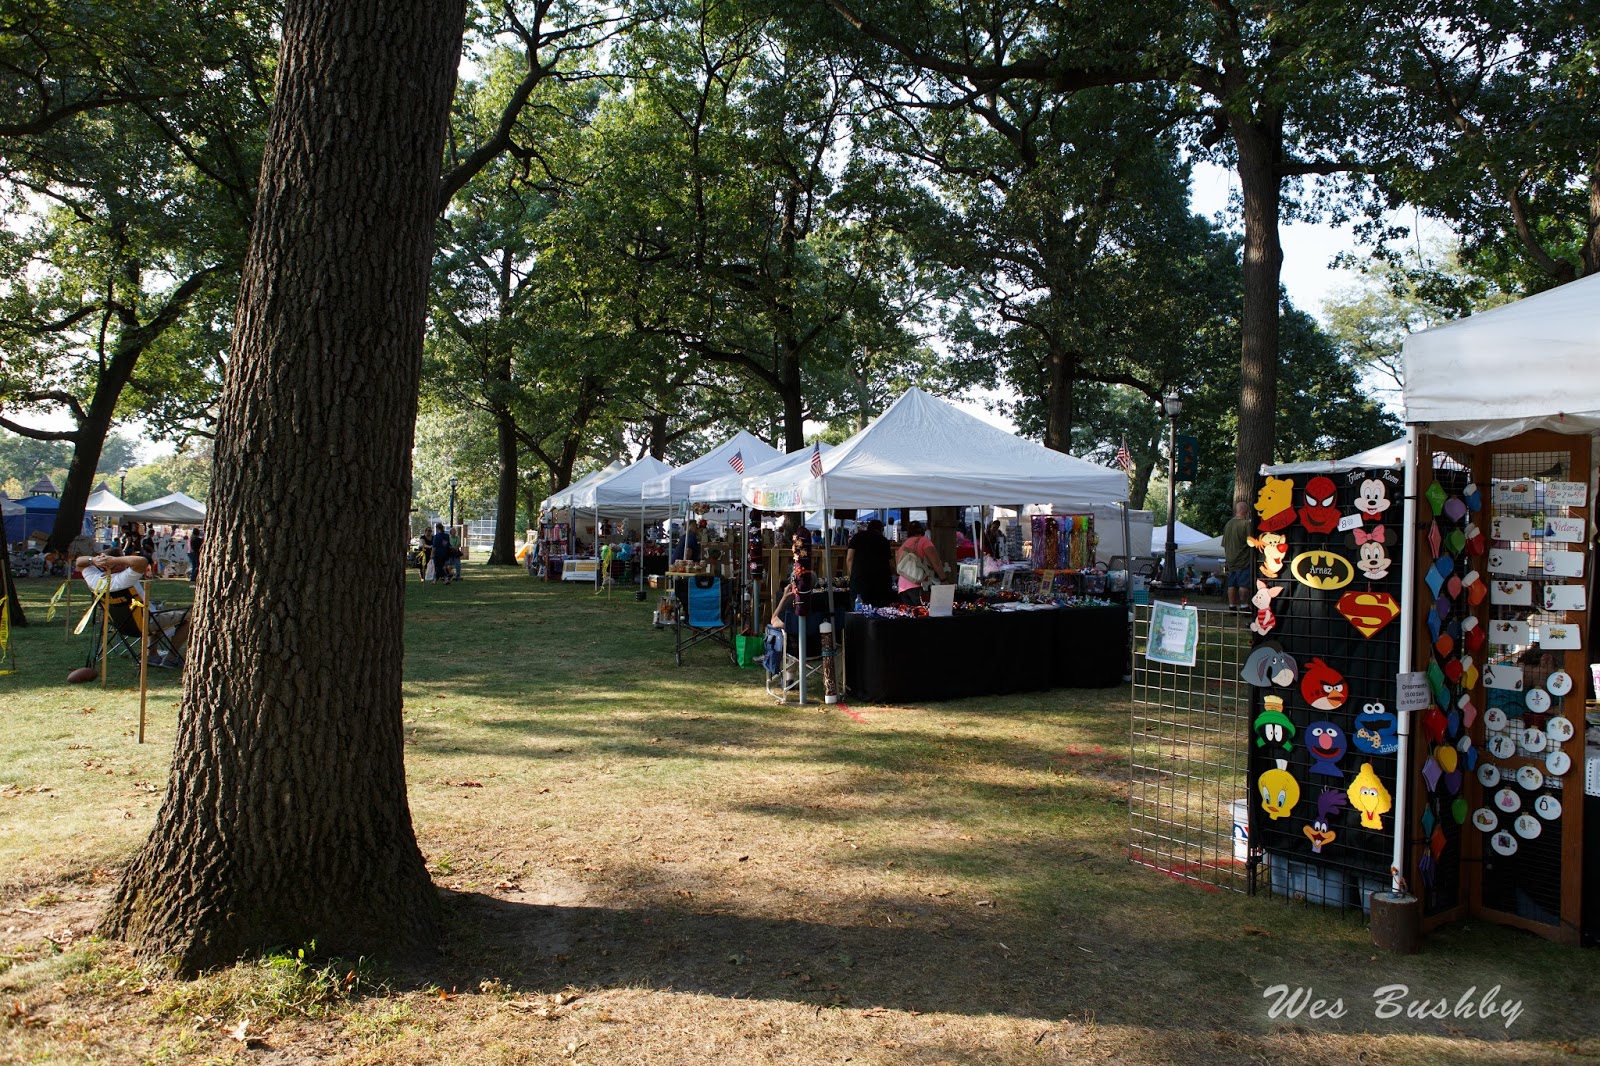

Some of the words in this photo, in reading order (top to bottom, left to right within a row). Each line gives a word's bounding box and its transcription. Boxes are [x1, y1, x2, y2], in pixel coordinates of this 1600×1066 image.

[1347, 471, 1366, 485] Tylers
[1382, 470, 1400, 485] Room
[1309, 565, 1333, 575] Arnez
